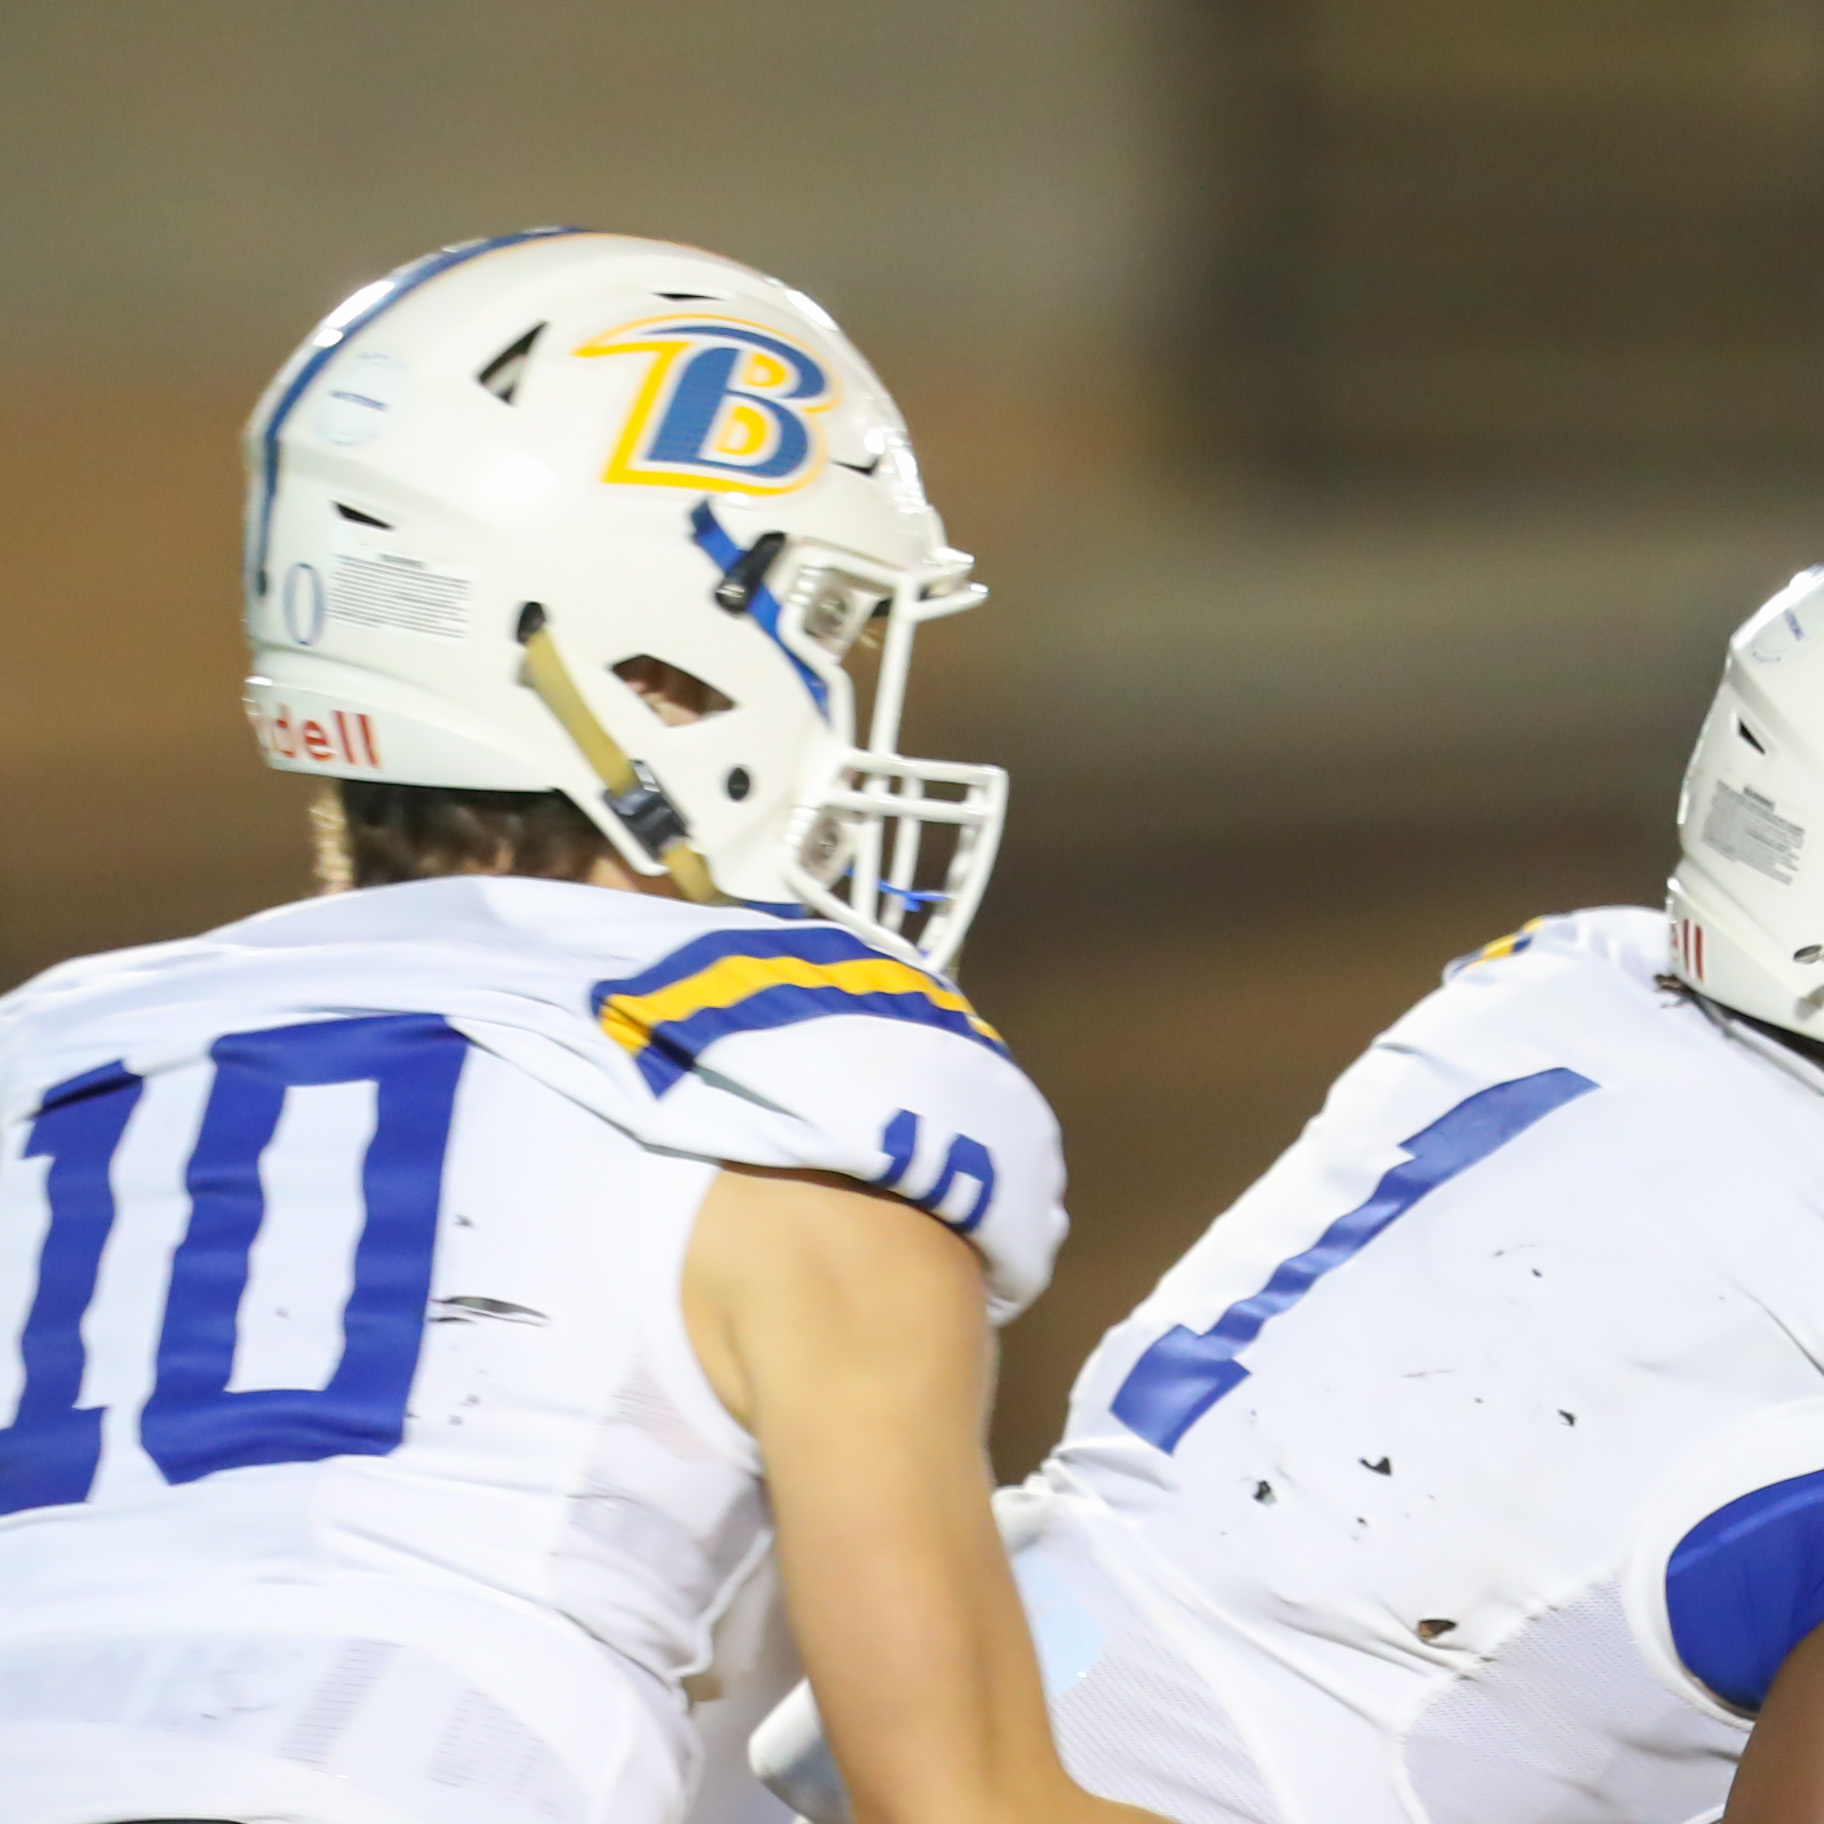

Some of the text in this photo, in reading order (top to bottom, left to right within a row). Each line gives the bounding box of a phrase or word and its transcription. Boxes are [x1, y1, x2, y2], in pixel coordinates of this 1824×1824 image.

[574, 313, 844, 496] B
[254, 702, 382, 770] dell
[878, 1107, 999, 1234] 10
[1111, 1066, 1602, 1457] 1
